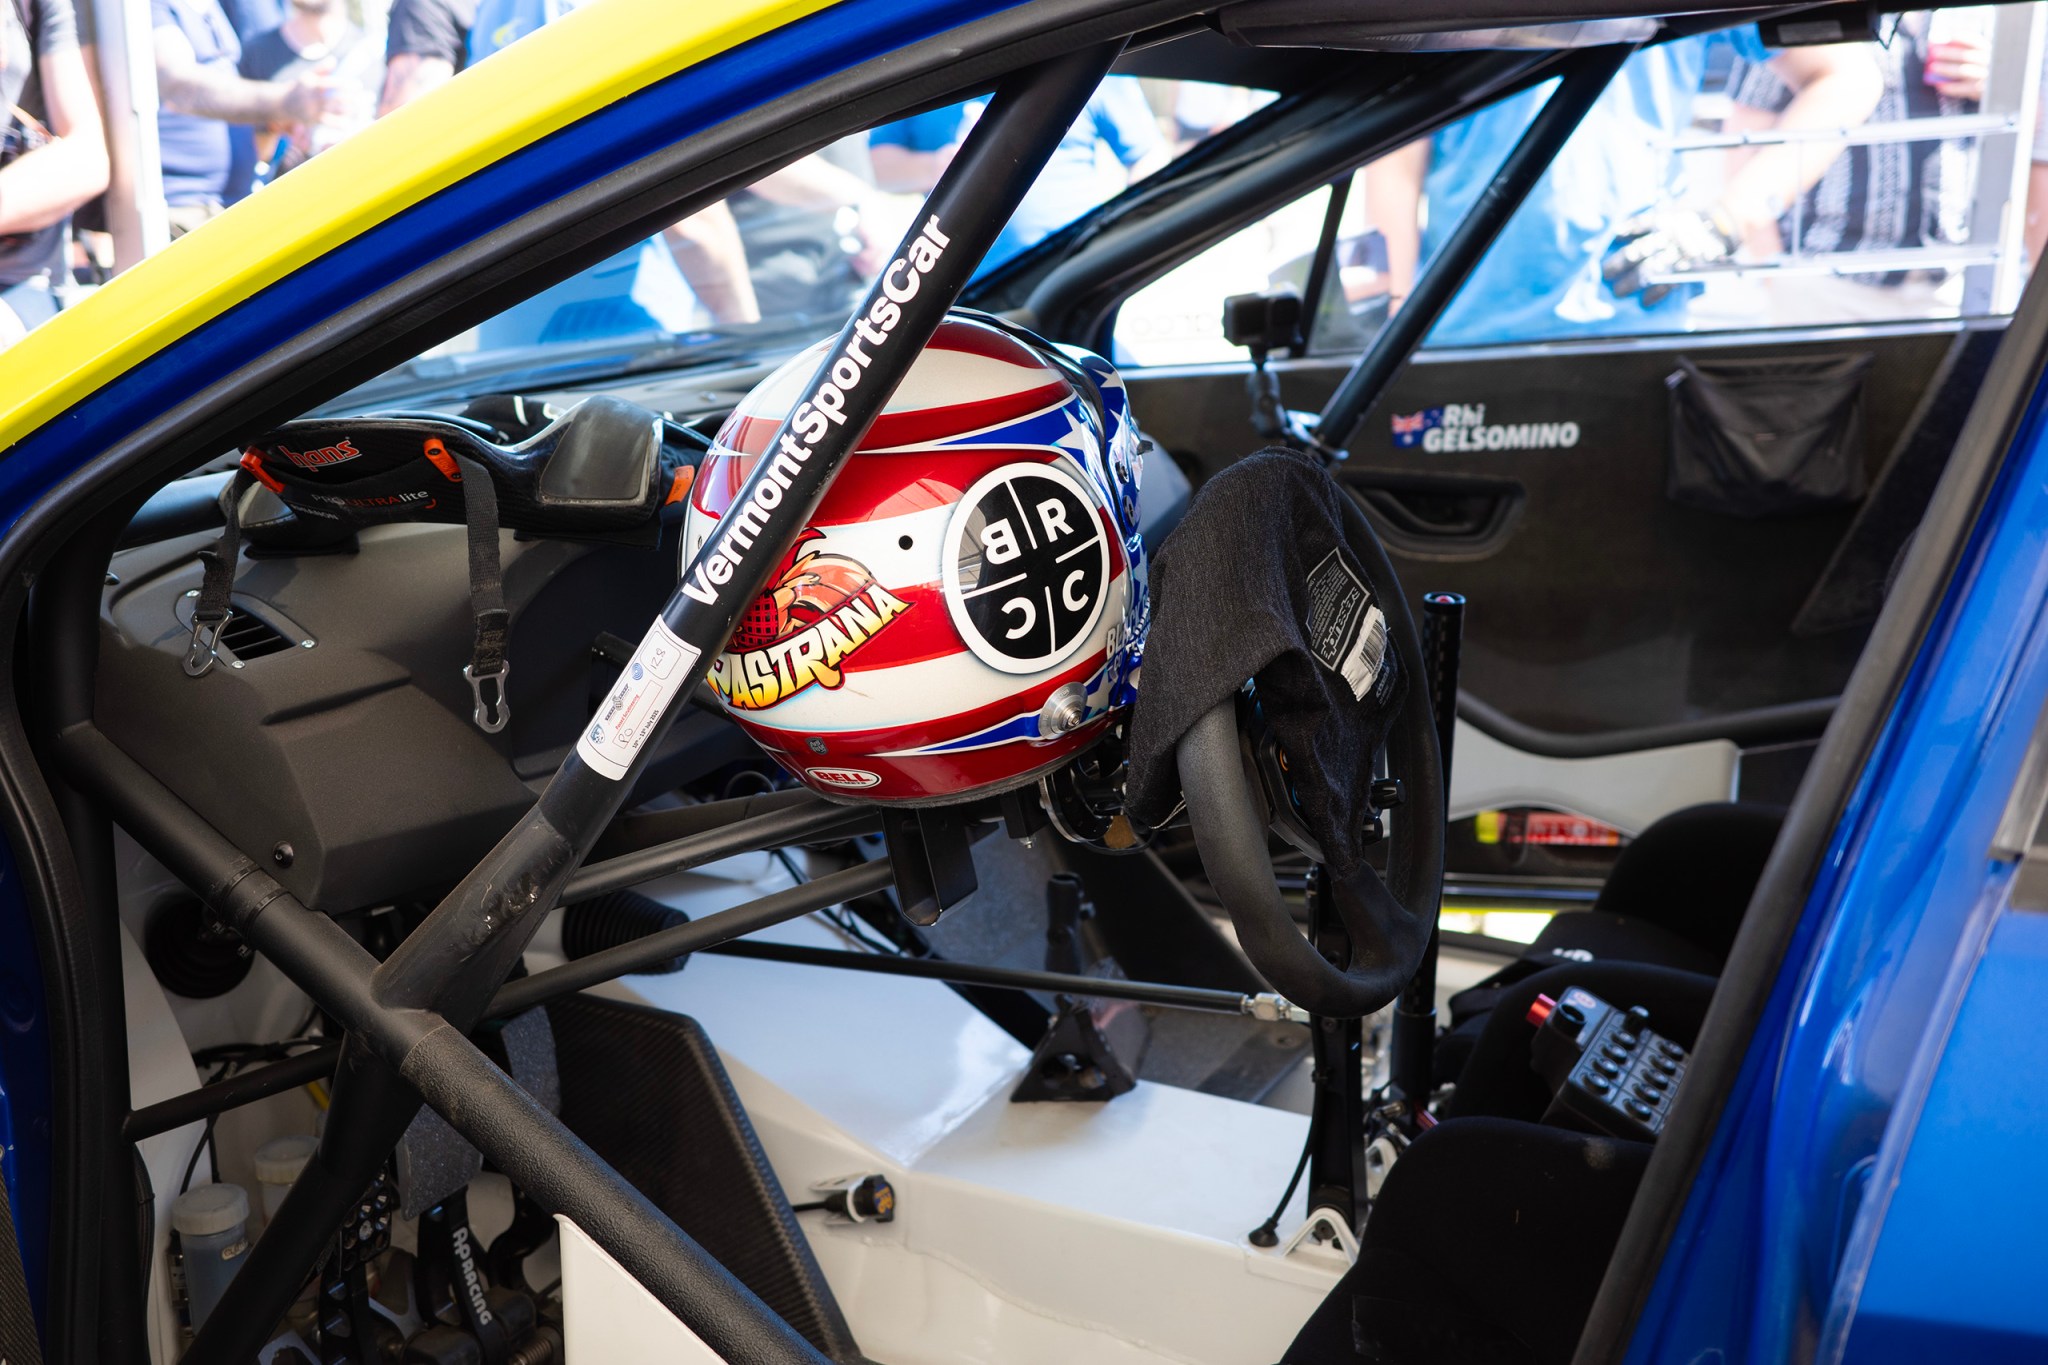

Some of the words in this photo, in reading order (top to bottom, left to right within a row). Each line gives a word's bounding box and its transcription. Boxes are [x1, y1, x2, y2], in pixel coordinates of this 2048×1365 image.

[682, 213, 951, 606] VermontSportsCar
[1442, 403, 1486, 427] Rhi
[1422, 421, 1580, 453] GELSOMINO
[278, 438, 362, 472] hans
[706, 582, 912, 709] PASTRANA
[813, 770, 871, 782] BELL
[453, 1226, 471, 1260] AP
[461, 1257, 493, 1326] RACING
